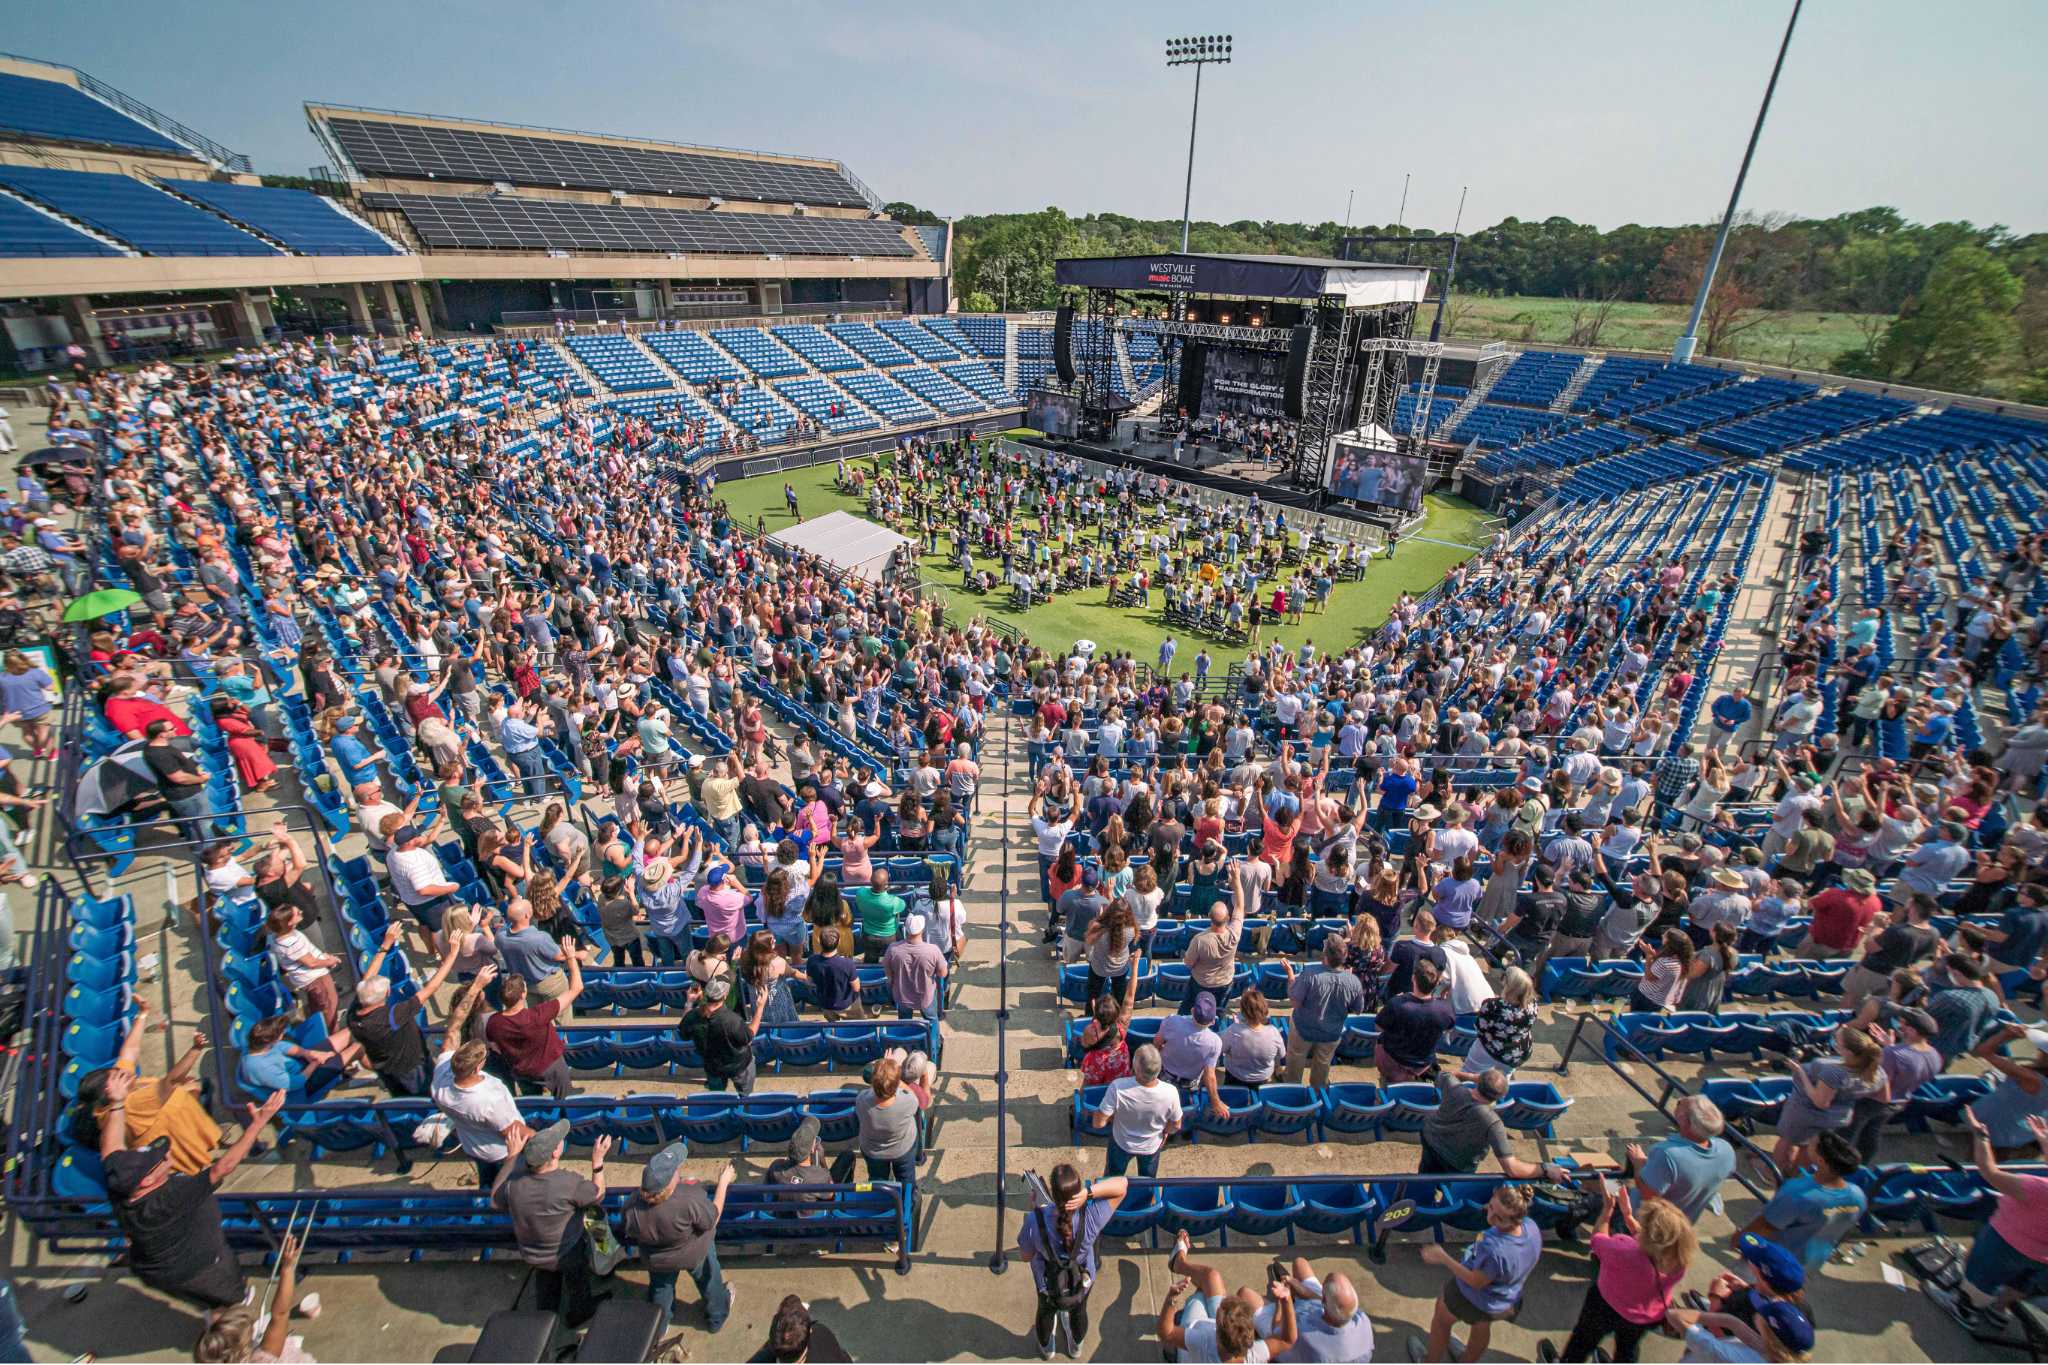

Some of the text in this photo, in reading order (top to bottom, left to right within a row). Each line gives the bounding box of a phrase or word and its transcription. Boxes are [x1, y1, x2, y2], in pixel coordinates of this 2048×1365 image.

[1150, 263, 1197, 275] WESTVILLE
[1171, 274, 1195, 284] BOWL
[1214, 378, 1230, 386] FOR
[1232, 380, 1249, 388] THE
[1249, 383, 1278, 392] GLORY
[1214, 385, 1284, 400] TRANSFORMATION
[1383, 1207, 1411, 1222] 203
